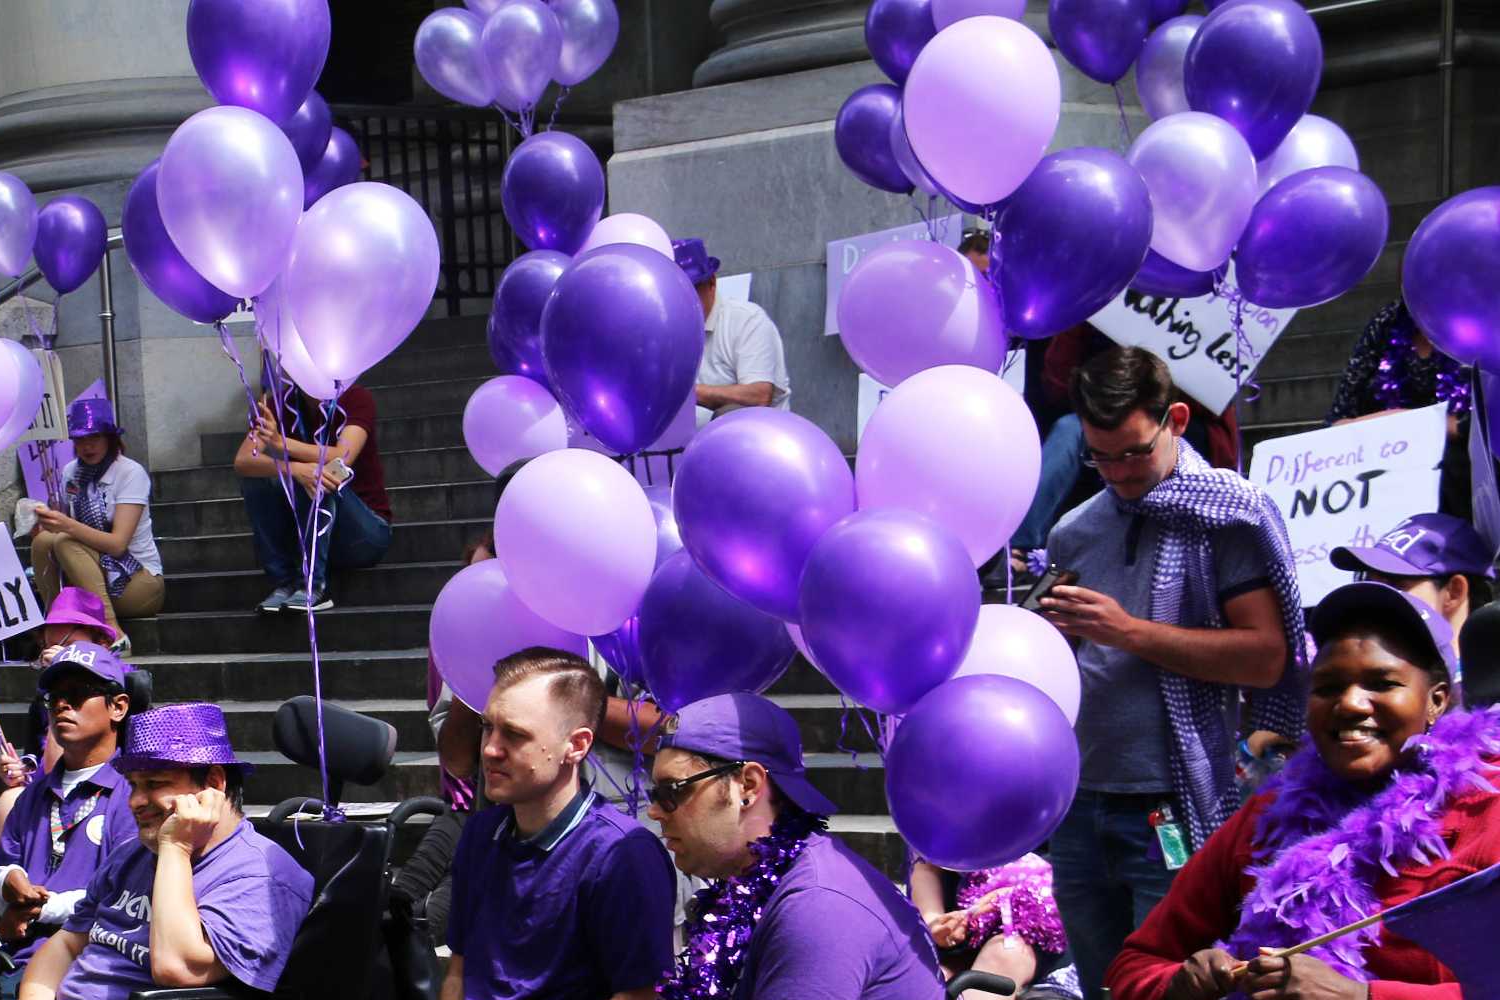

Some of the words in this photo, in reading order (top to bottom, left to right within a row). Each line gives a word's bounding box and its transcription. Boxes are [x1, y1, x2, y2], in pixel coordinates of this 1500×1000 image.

[1266, 445, 1364, 486] Different
[1380, 440, 1408, 459] to
[1290, 469, 1389, 519] NOT
[1293, 542, 1329, 565] ess
